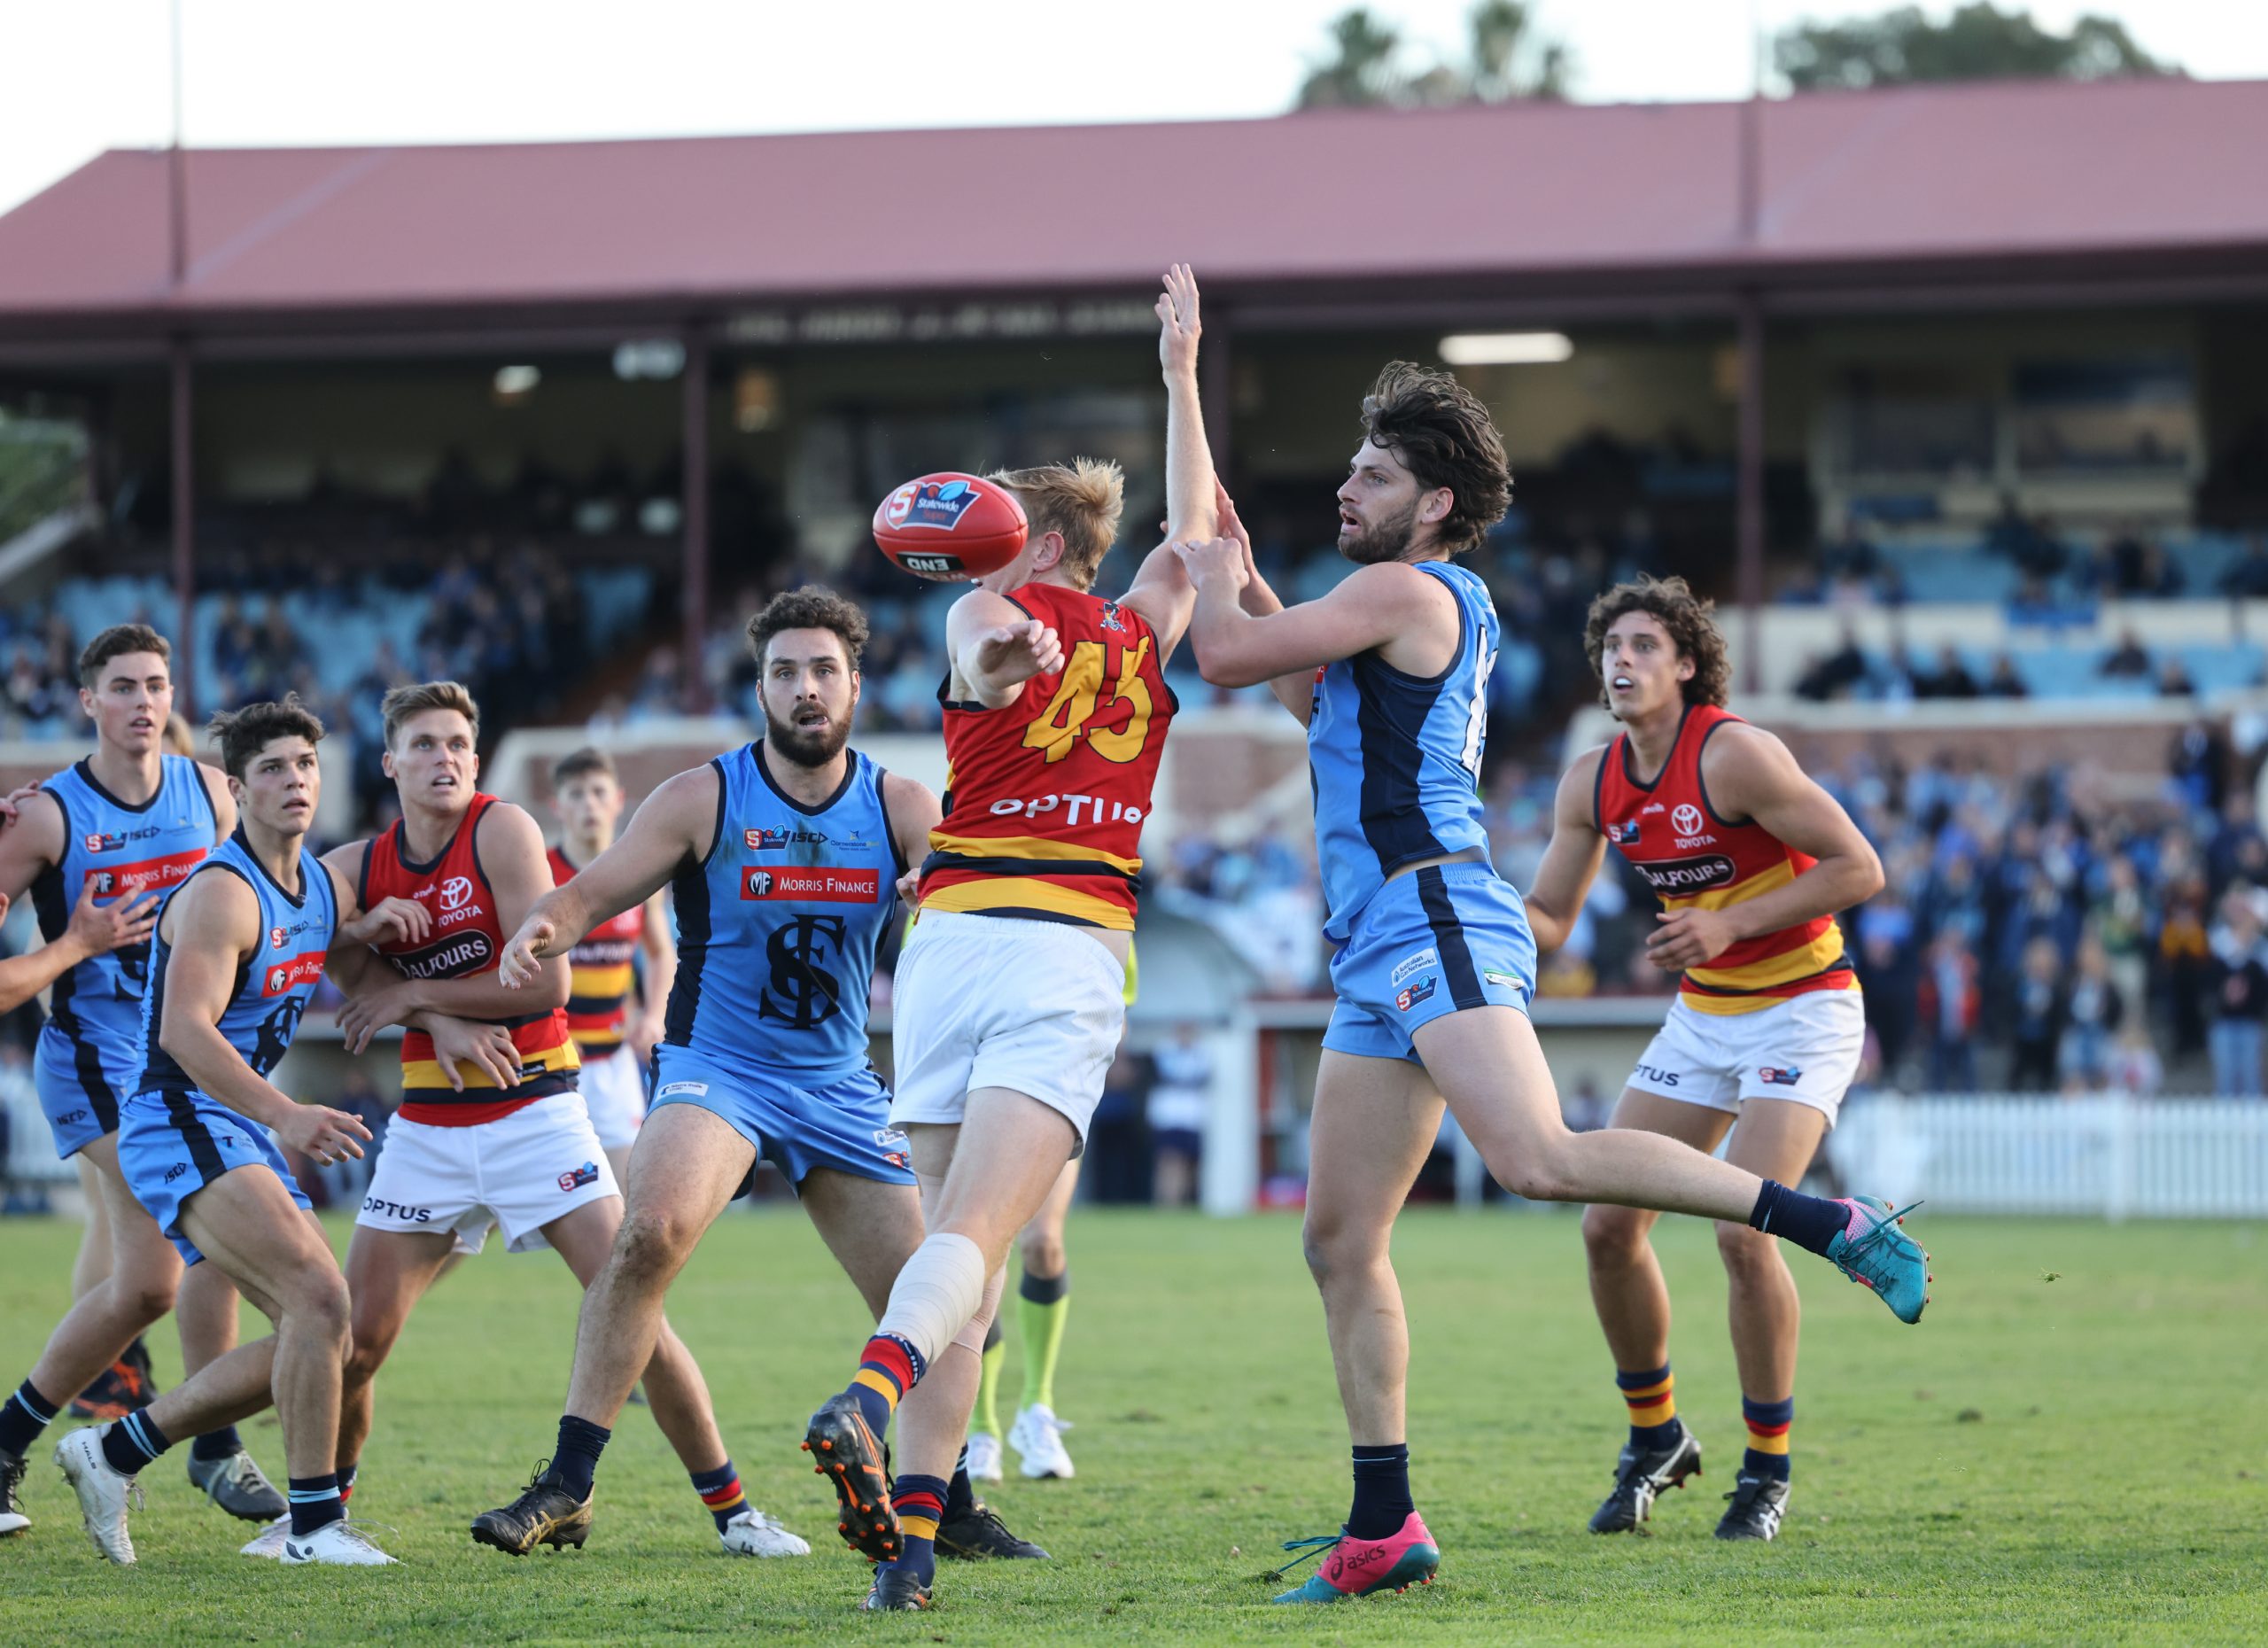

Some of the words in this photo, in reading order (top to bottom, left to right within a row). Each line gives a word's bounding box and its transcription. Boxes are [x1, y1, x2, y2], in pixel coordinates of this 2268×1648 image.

[917, 497, 959, 512] Statewide
[1021, 635, 1153, 764] 45
[1674, 834, 1718, 850] TOYOTA
[120, 869, 160, 888] MORRIS
[162, 859, 197, 880] FINAN
[780, 876, 823, 891] MORRIS
[827, 877, 875, 894] FINANCE
[1400, 955, 1424, 972] Australian
[1408, 958, 1435, 973] Networks
[363, 1196, 432, 1224] OPTUS
[1348, 1544, 1386, 1571] asics
